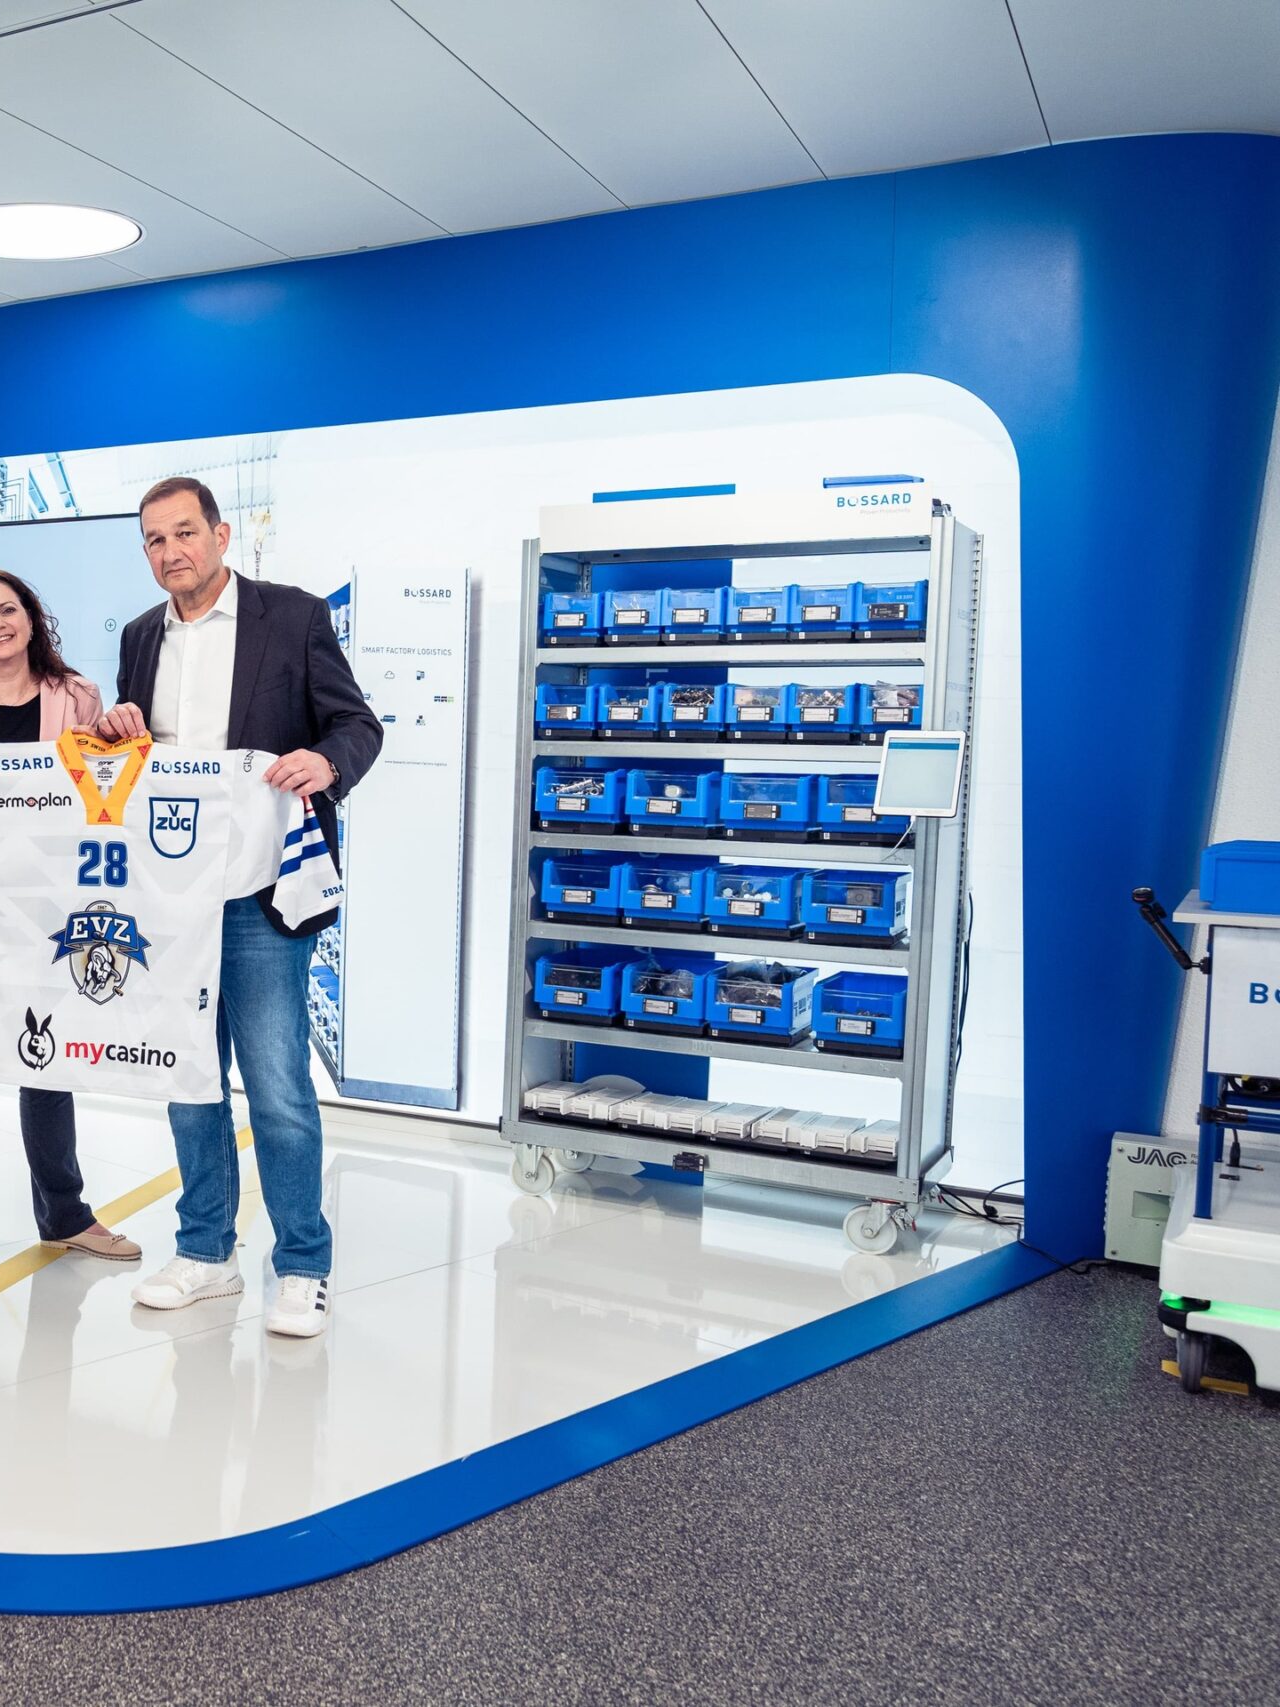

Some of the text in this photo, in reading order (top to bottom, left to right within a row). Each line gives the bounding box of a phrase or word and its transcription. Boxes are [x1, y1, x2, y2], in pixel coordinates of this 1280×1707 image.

[836, 493, 912, 508] BOSSARD
[404, 588, 452, 598] BOSSARD
[361, 646, 452, 656] SMART FACTORY LOGISTICS
[151, 761, 221, 774] BOSSARD
[167, 804, 180, 817] V
[155, 817, 192, 831] ZUG
[77, 840, 128, 888] 28
[322, 884, 345, 898] 2024
[70, 916, 131, 943] EVZ
[1249, 982, 1280, 1004] B
[65, 1041, 177, 1069] mycasino
